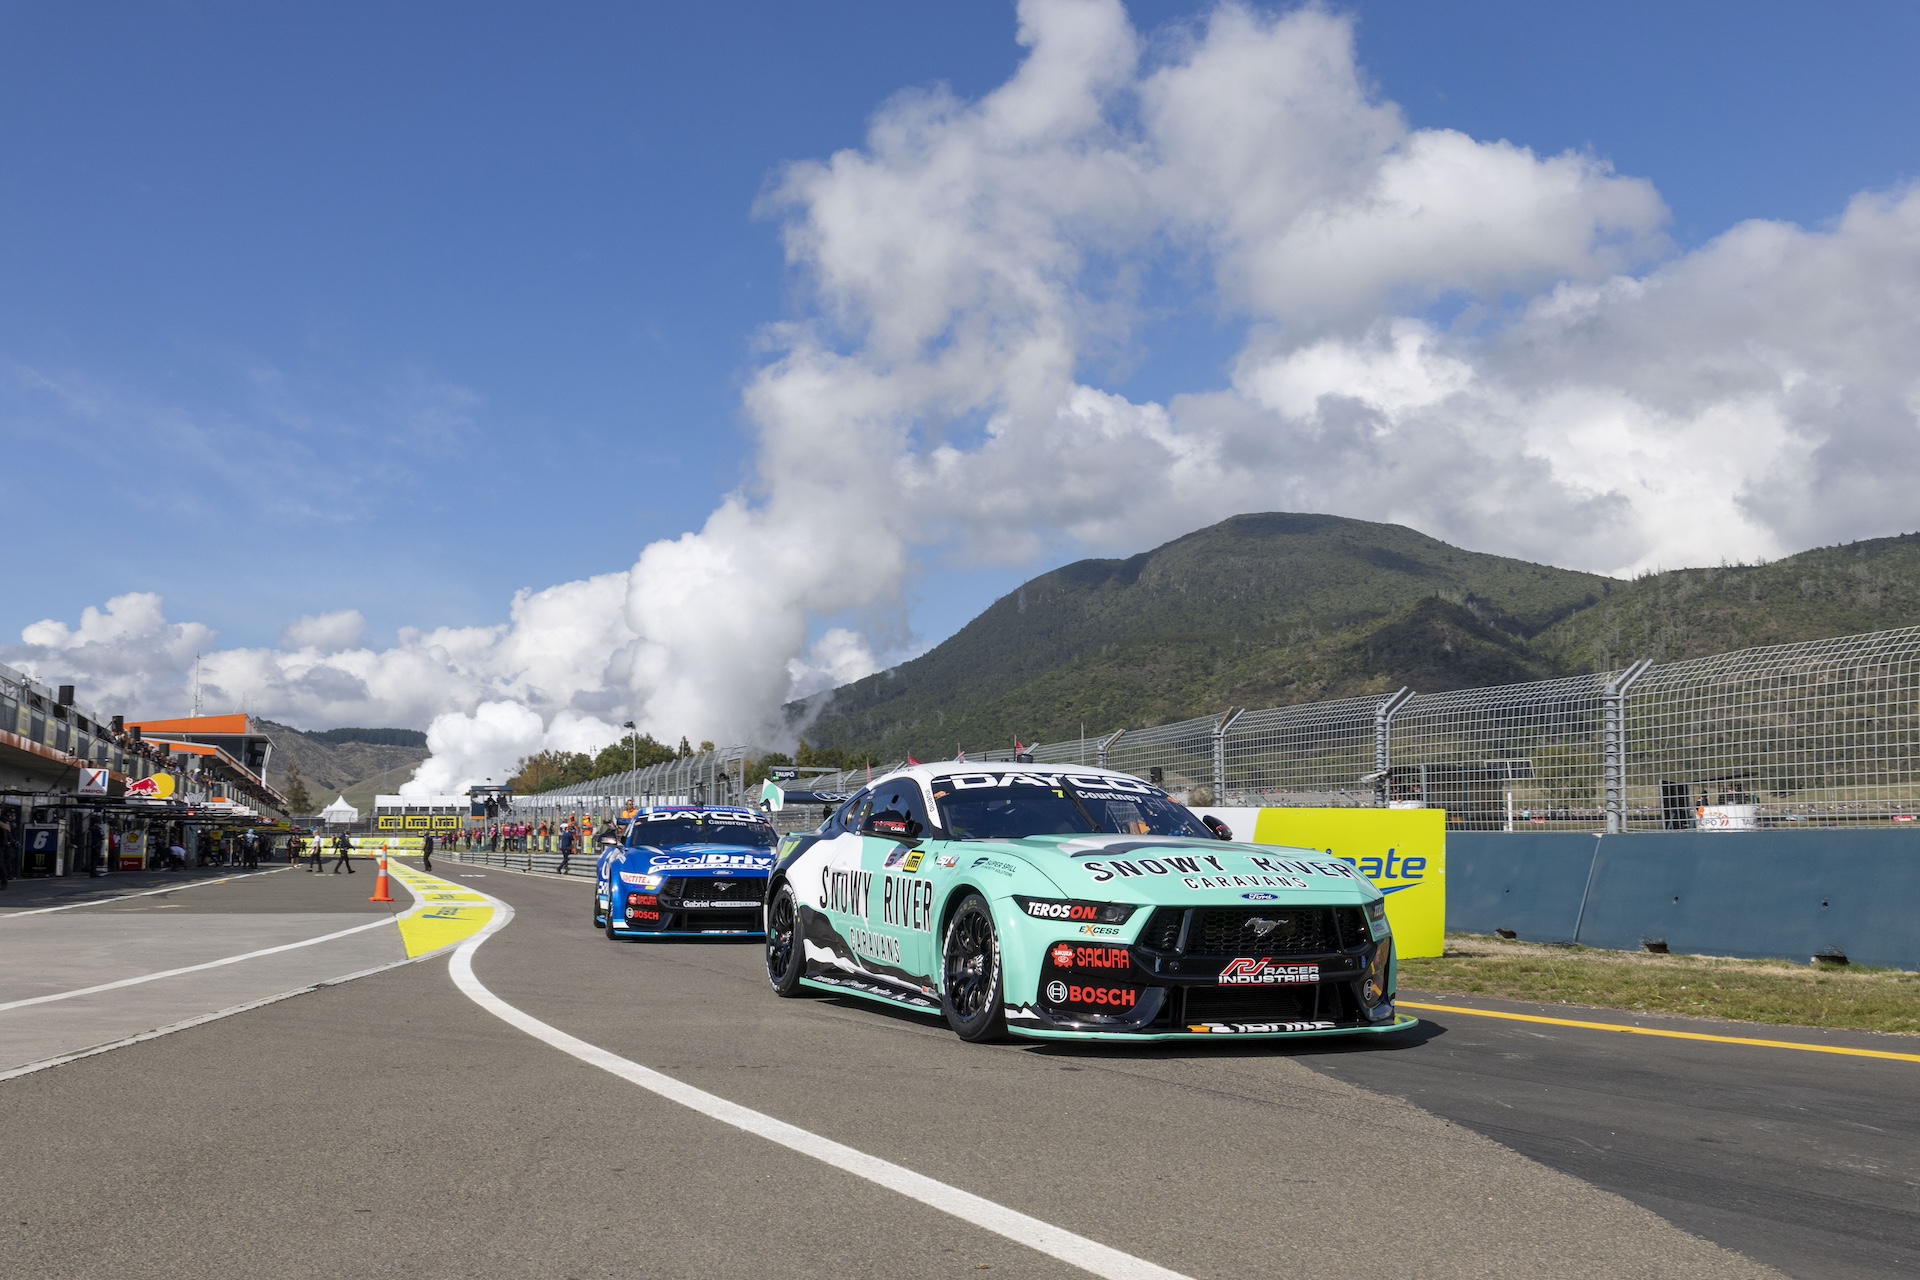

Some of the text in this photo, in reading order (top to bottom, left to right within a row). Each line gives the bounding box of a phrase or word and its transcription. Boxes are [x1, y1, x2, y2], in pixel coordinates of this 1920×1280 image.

[949, 773, 1154, 795] DAYCO
[1052, 789, 1064, 798] 7
[1076, 789, 1143, 804] Courtney
[646, 811, 758, 823] DAYCO
[708, 819, 747, 827] Cameron
[33, 831, 49, 849] 6
[650, 854, 774, 865] CoolDriv
[986, 860, 1017, 873] SUPER SPILL
[1084, 855, 1227, 882] SNOWY
[1249, 857, 1357, 881] RIVER
[1185, 875, 1308, 889] CARAVANS
[683, 900, 710, 908] Gabriel
[819, 865, 872, 919] SNOWY
[884, 875, 933, 932] RIVER
[634, 910, 659, 920] BOSCH
[1027, 901, 1097, 920] TEROSON
[1079, 924, 1120, 937] EXCESS
[850, 928, 900, 964] CARAVANS
[1076, 947, 1130, 969] SAKURA
[1264, 966, 1319, 975] RACER
[1218, 974, 1320, 984] INDUSTRIES
[1069, 985, 1136, 1006] BOSCH
